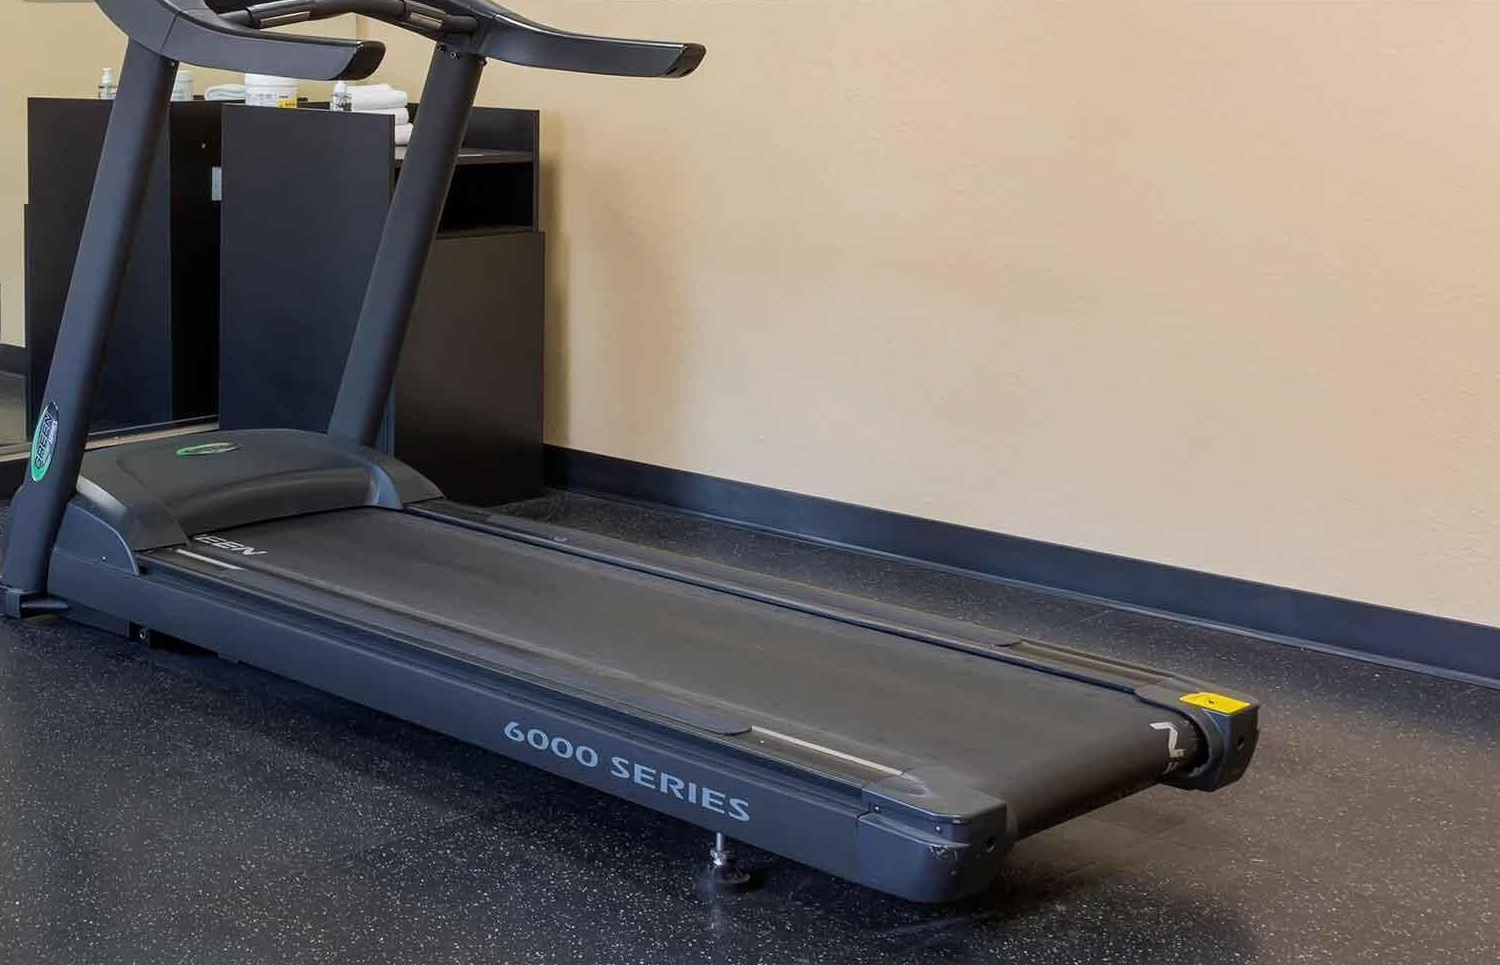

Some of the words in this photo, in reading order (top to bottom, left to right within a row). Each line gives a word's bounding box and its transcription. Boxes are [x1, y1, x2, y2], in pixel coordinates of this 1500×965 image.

[35, 411, 54, 469] GREEN
[194, 534, 268, 556] EEN
[503, 720, 598, 768] 6000
[610, 755, 751, 822] SERIES
